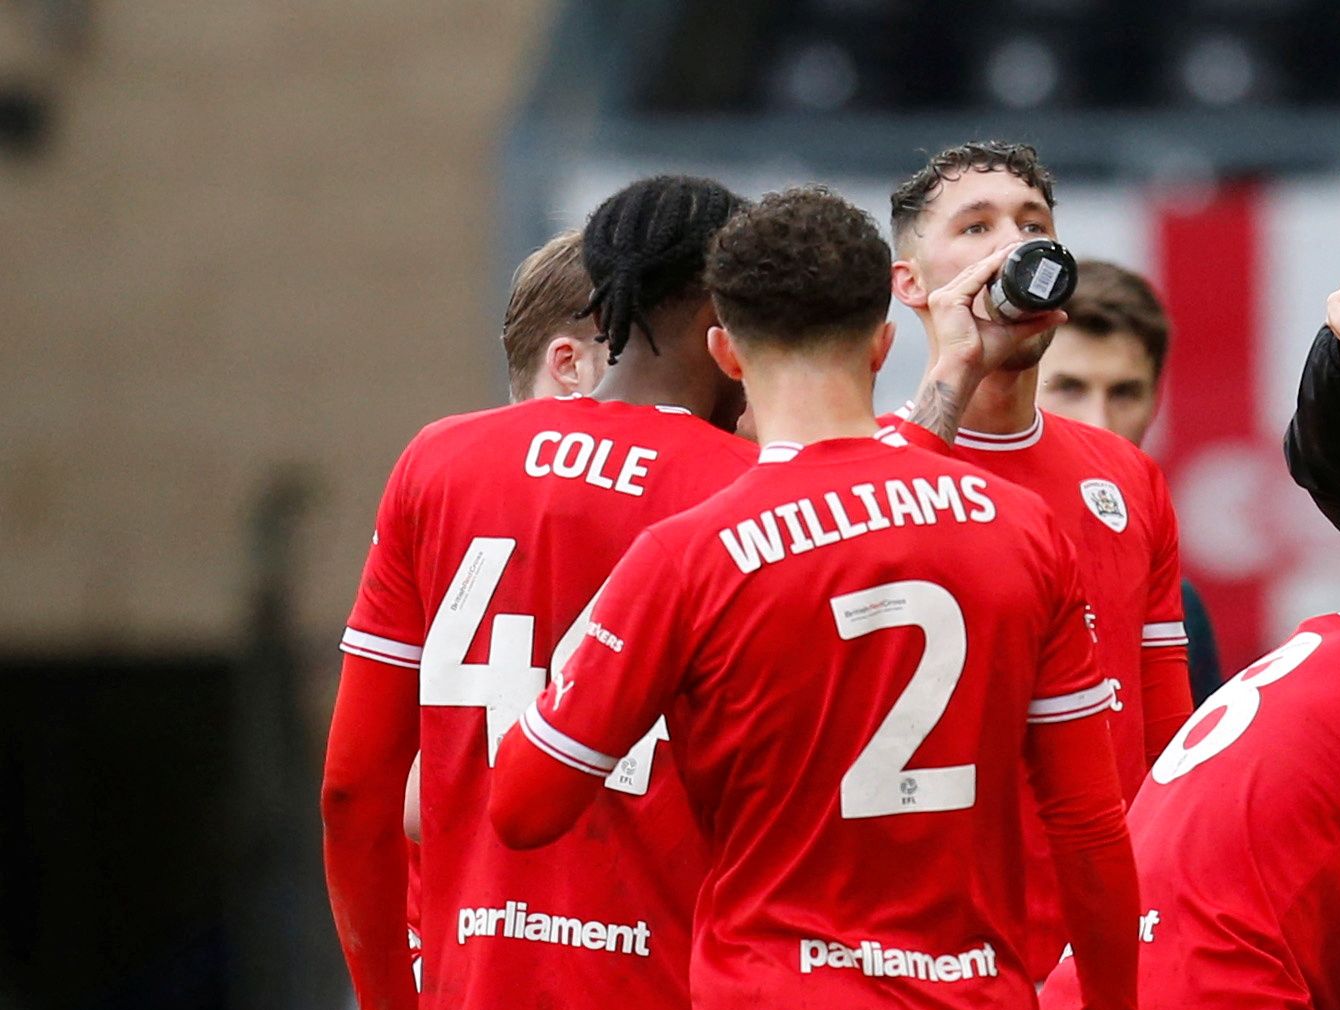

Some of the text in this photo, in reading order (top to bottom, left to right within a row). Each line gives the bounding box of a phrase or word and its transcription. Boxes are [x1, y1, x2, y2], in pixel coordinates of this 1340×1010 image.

[524, 430, 658, 496] COLE
[719, 474, 997, 574] WILLIAMS
[830, 578, 977, 820] 2
[1152, 631, 1324, 785] 8
[456, 901, 650, 958] parliament
[800, 939, 999, 982] parliament
